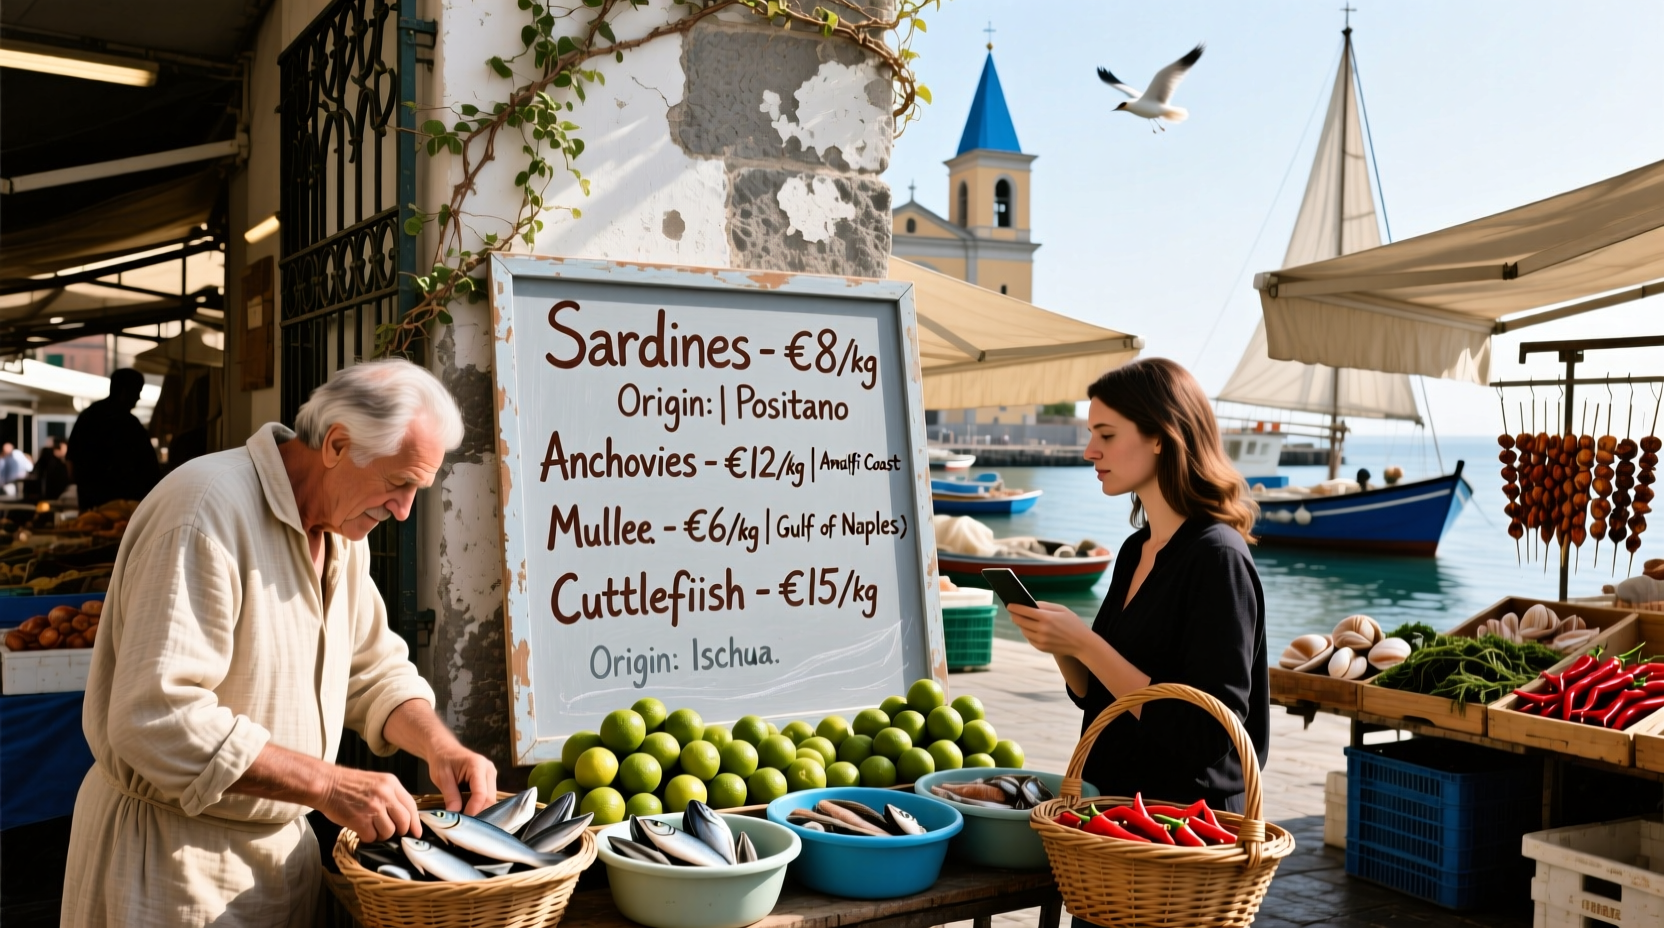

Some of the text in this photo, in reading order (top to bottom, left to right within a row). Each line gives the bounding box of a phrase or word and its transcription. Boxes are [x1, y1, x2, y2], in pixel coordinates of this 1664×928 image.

[545, 300, 751, 371] Sardines
[783, 328, 877, 391] €8/kg
[617, 382, 713, 433] Origin:
[736, 384, 849, 421] Positano
[539, 430, 698, 483] Anchovies
[723, 445, 805, 489] €12/kg
[863, 452, 902, 472] Coast
[682, 507, 760, 554] €6/kg
[776, 513, 816, 543] Gulf
[819, 513, 838, 540] of
[550, 567, 746, 628] Cuttlefiish
[778, 566, 878, 619] €15/kg
[589, 644, 679, 689] Origin:
